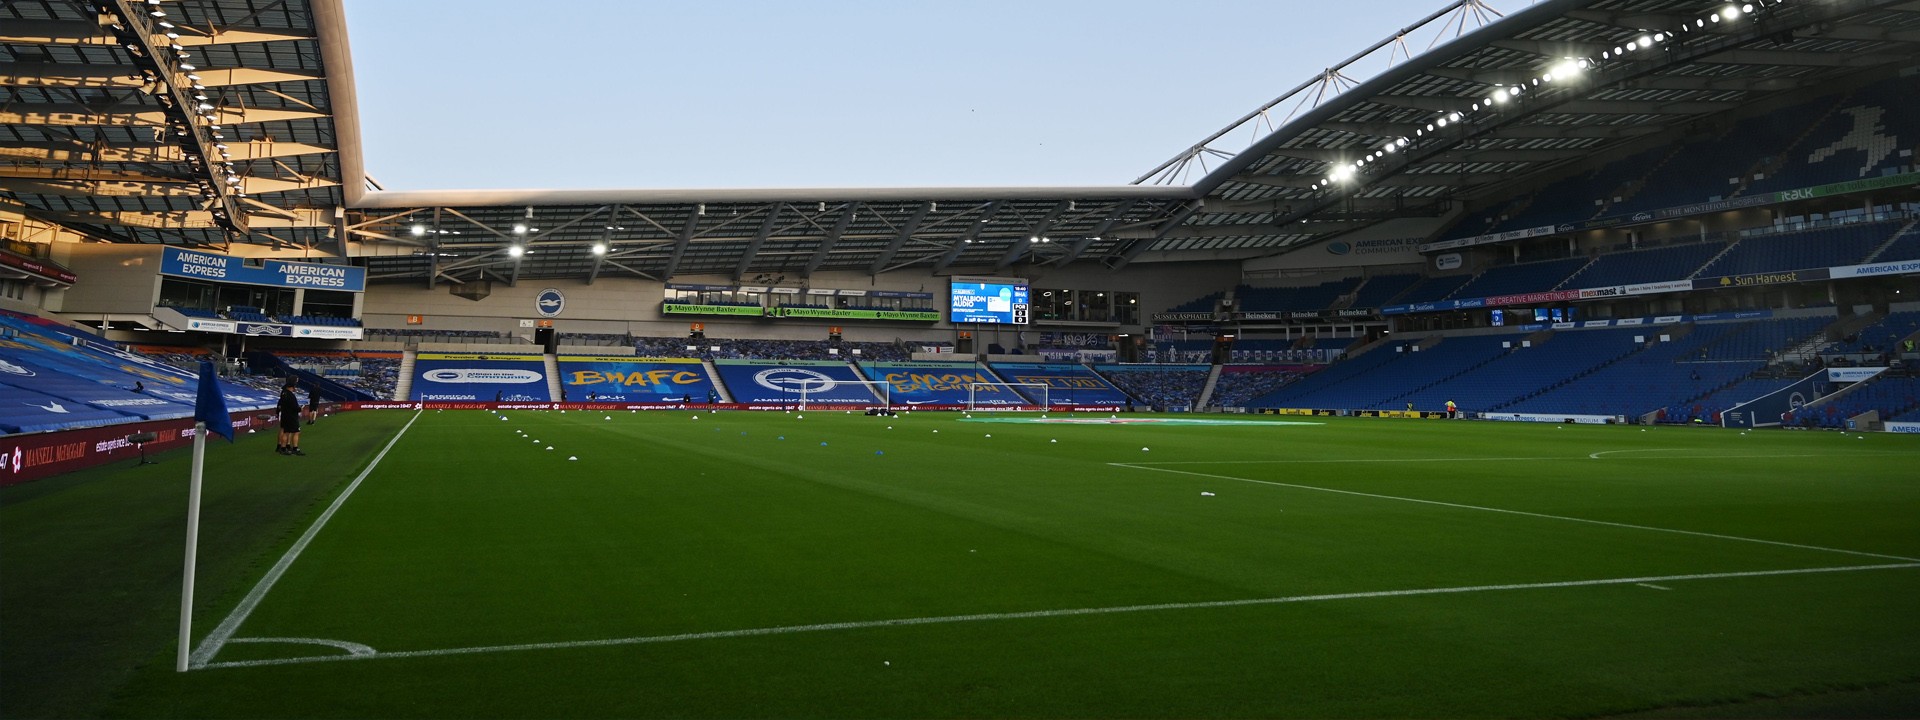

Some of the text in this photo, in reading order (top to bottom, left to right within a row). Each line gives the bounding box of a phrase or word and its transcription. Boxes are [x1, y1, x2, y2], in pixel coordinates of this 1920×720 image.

[1684, 202, 1731, 214] MONTEFIORE
[1356, 240, 1403, 248] AMERICAN
[1355, 246, 1412, 255] COMMUNITY
[177, 252, 227, 268] AMERICAN
[182, 264, 226, 278] EXPRESS
[278, 264, 345, 278] AMERICAN
[1856, 265, 1899, 274] AMERICAN
[286, 275, 345, 287] EXPRESS
[1735, 272, 1796, 286] Sun Harvest
[1498, 295, 1526, 304] CREATIVE
[1528, 292, 1565, 302] MARKETING
[1582, 287, 1617, 298] mexmast
[692, 306, 714, 314] Wynne
[886, 372, 990, 384] C'MON
[25, 445, 53, 468] MANSELL
